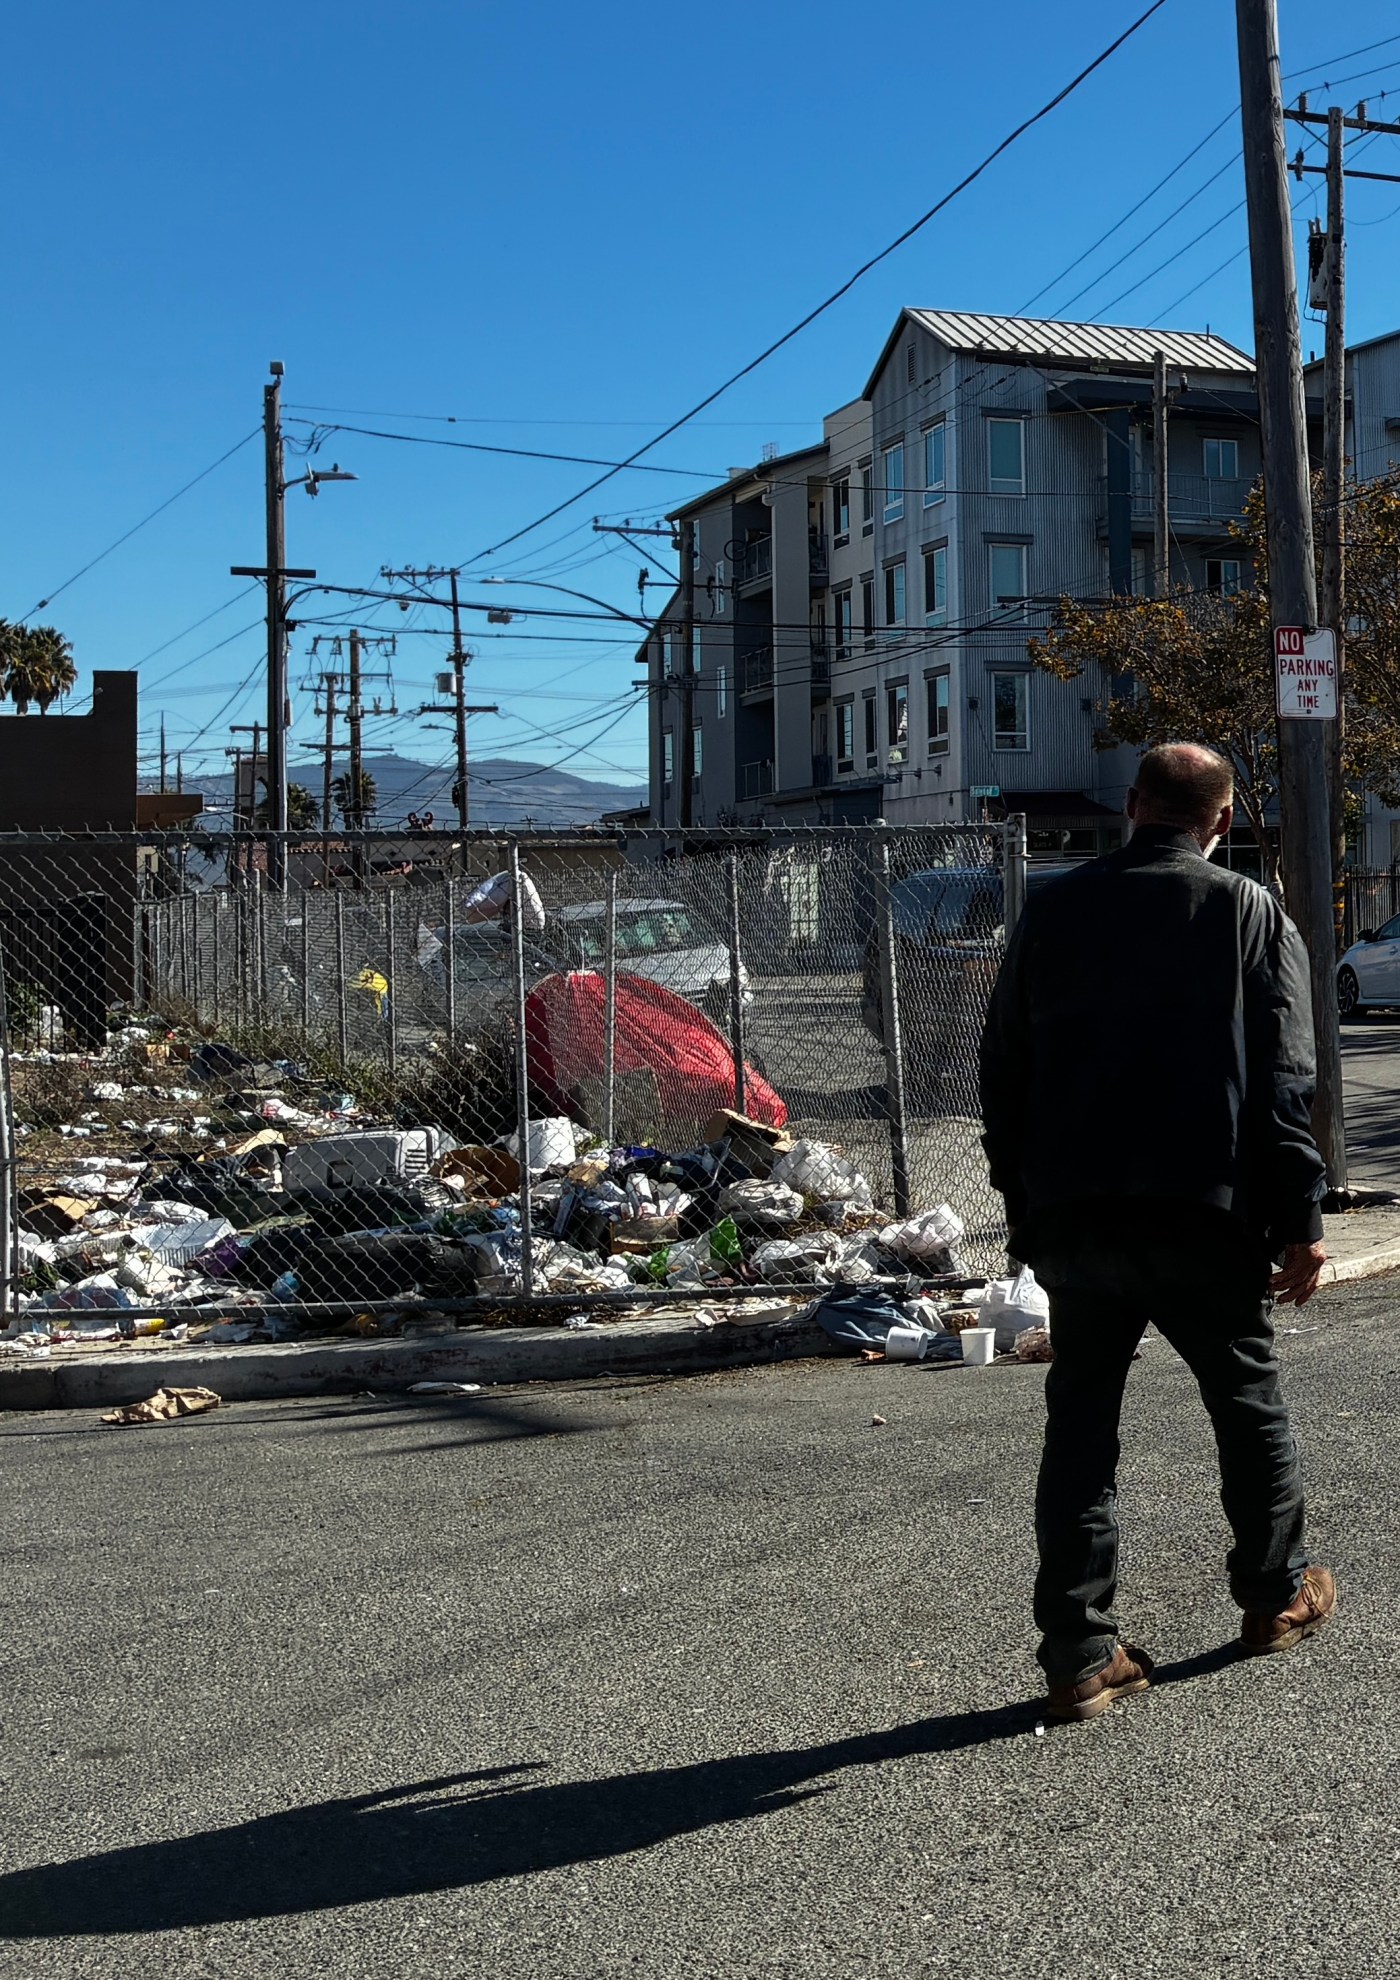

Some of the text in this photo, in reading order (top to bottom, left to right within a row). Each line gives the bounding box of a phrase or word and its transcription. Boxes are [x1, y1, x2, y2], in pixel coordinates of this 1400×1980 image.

[1280, 632, 1300, 651] NO
[1280, 659, 1334, 676] PARKING
[1297, 679, 1318, 692] ANY
[1297, 695, 1320, 708] TIME
